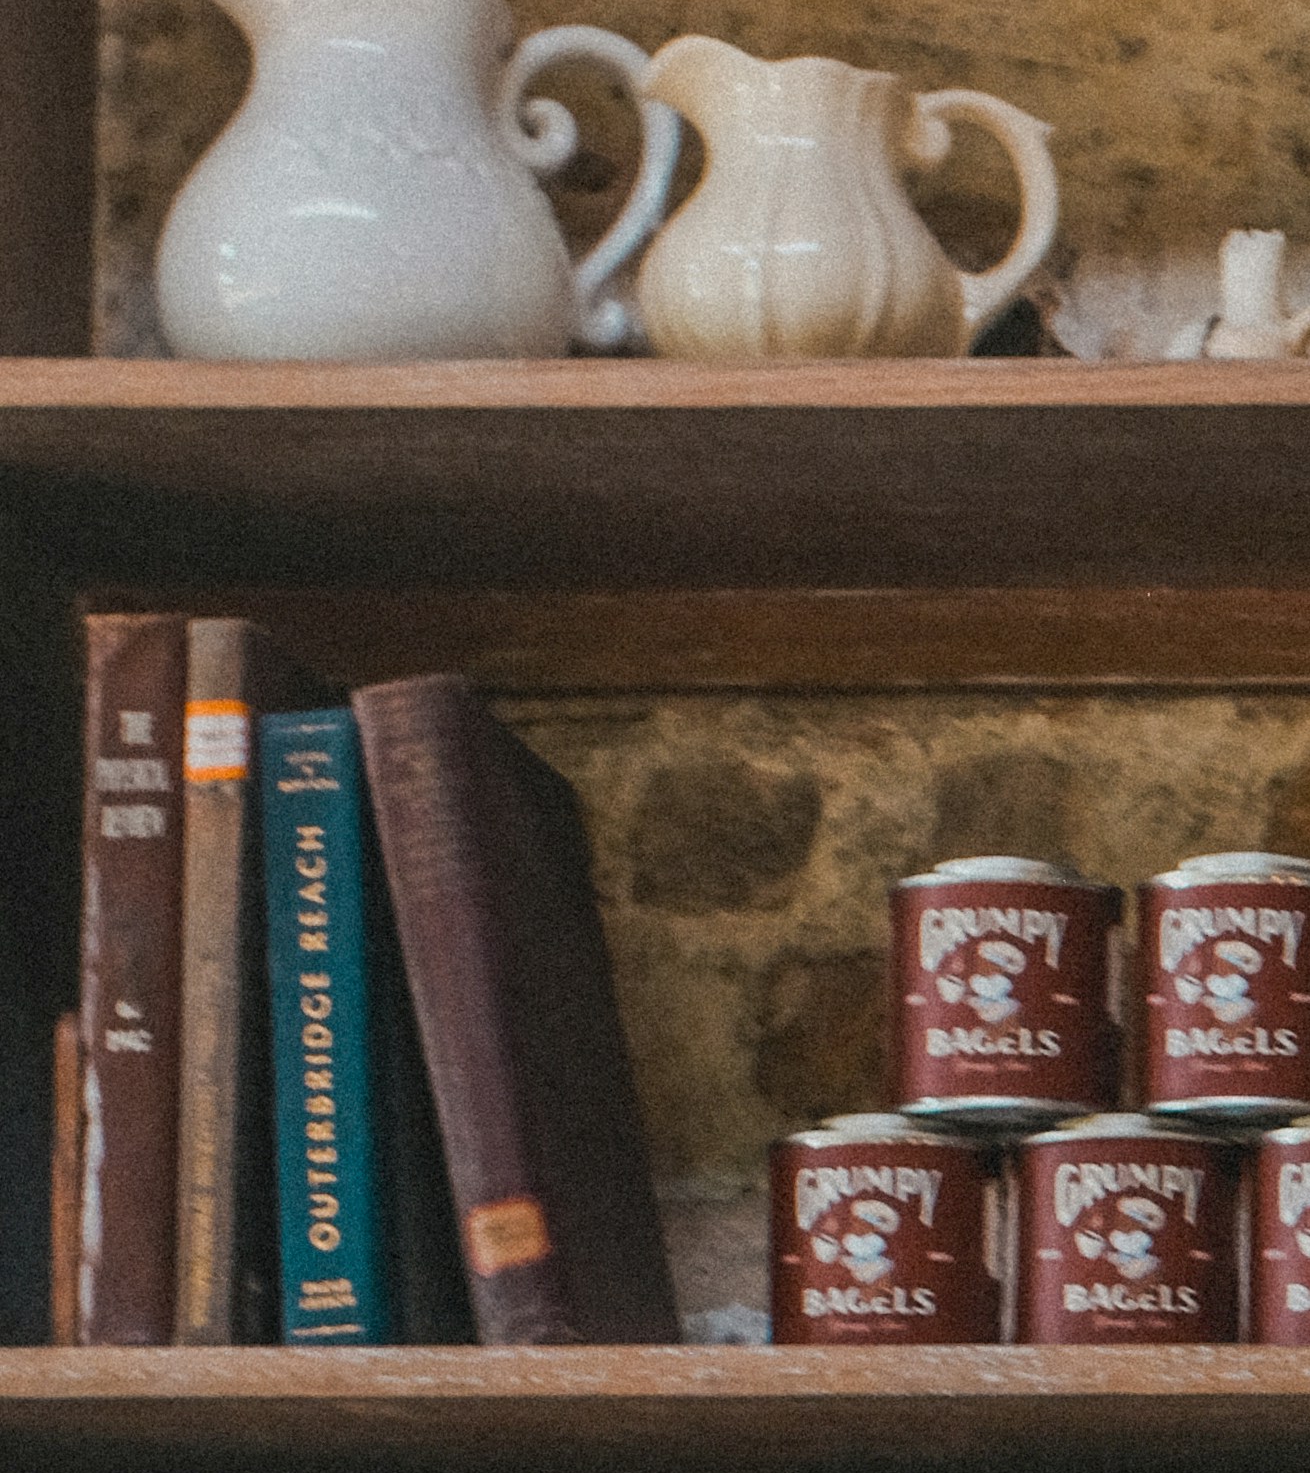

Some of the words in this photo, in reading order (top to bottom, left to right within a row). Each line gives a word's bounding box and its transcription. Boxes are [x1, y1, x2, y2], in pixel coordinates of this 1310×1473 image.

[295, 824, 329, 953] REACH
[919, 907, 1069, 975] GRUMPY
[1160, 907, 1306, 974] GRUMPY
[300, 970, 342, 1253] OUTERBRIDGE
[796, 1164, 943, 1231] GRUMPY
[1054, 1161, 1206, 1229] GRUMPY
